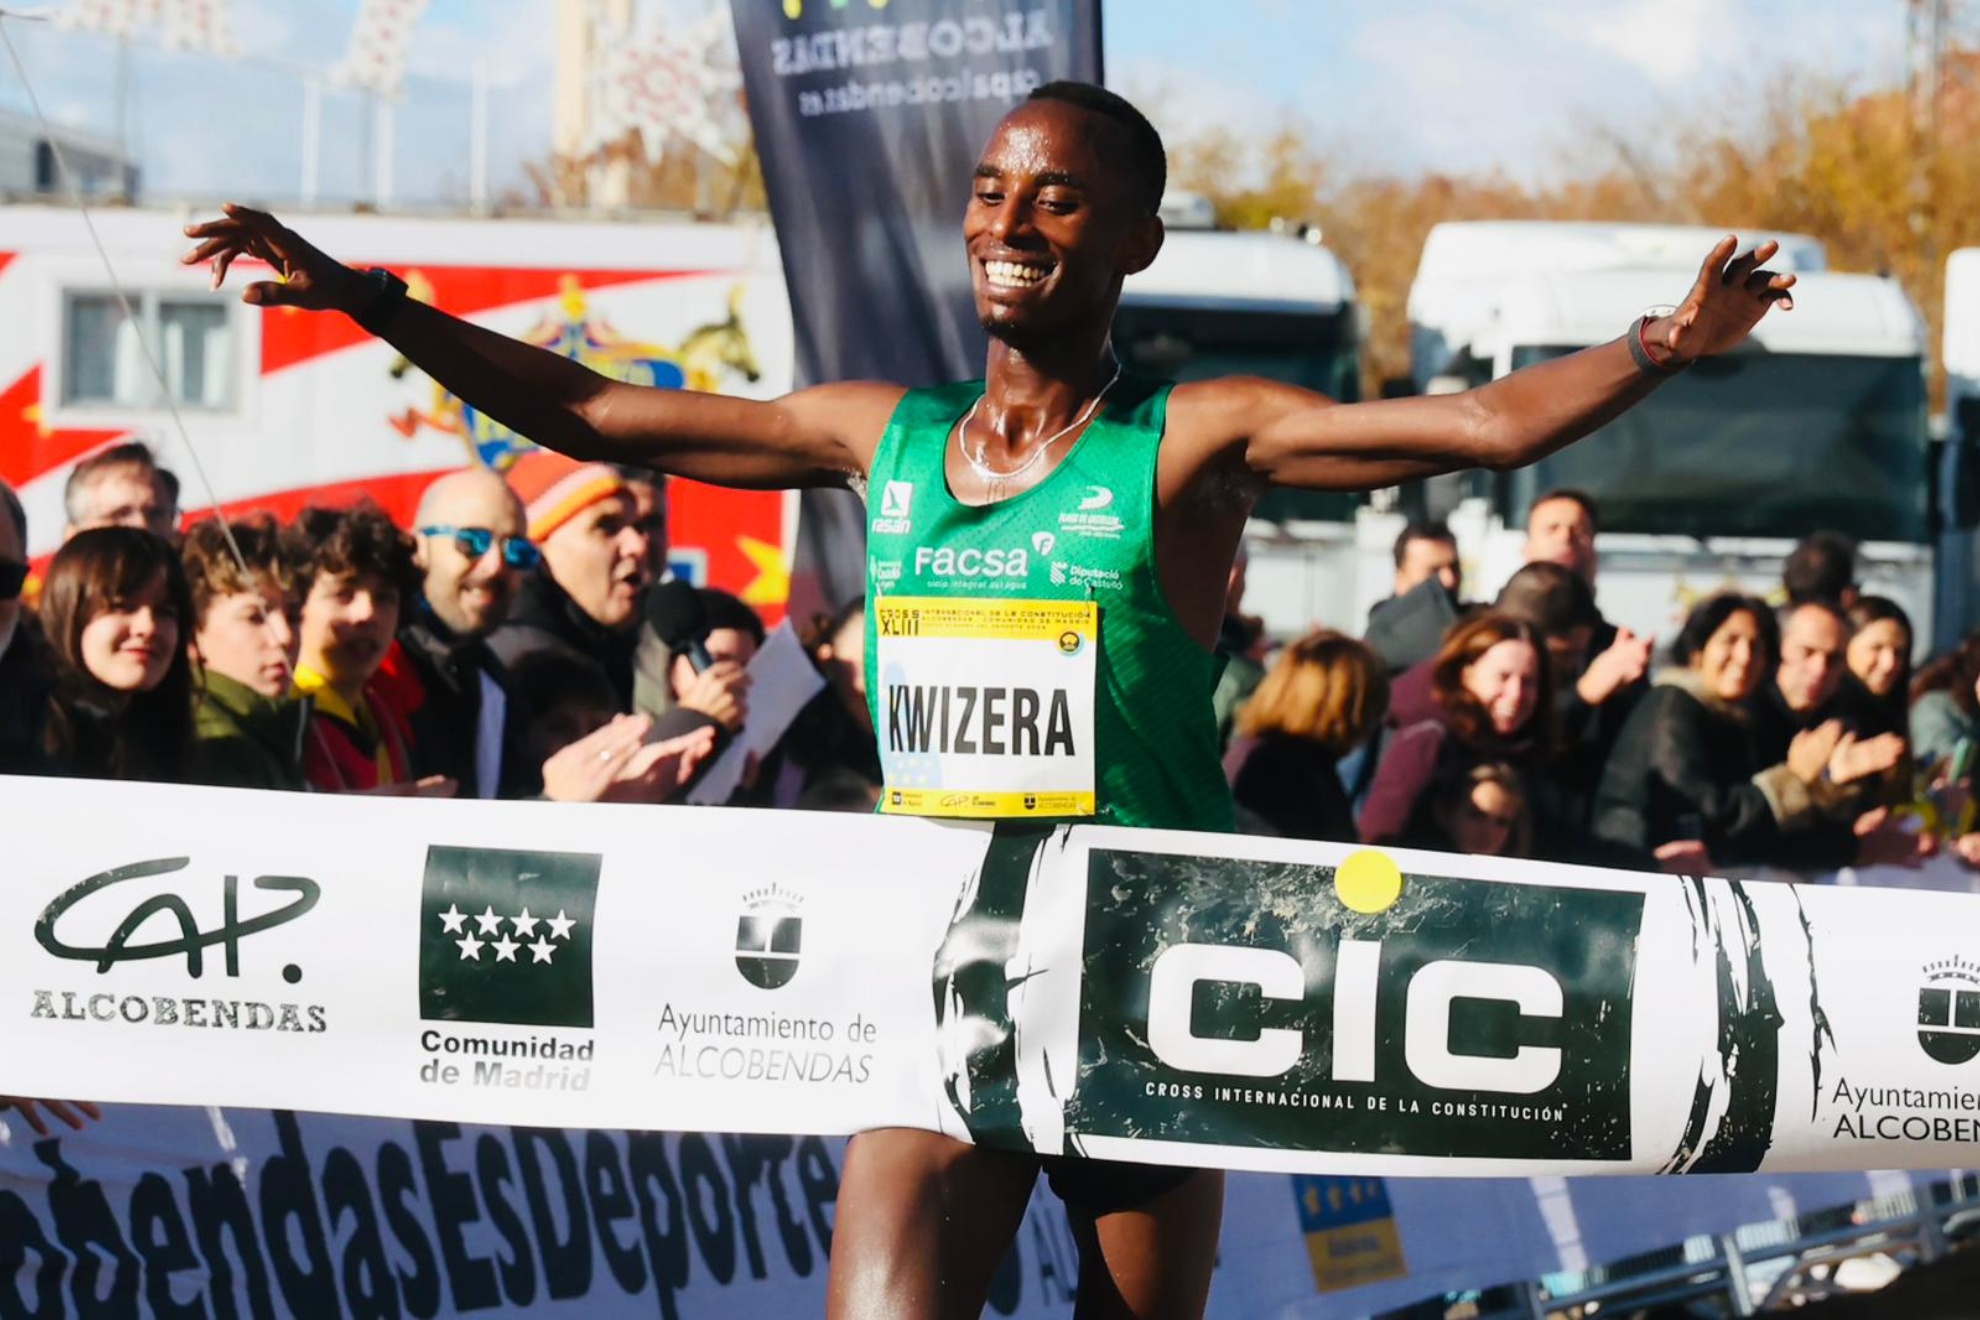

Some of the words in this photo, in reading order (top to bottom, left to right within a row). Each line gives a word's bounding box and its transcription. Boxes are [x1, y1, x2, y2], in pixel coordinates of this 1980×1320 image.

[879, 608, 920, 619] CROSS
[882, 619, 920, 636] XLIII
[888, 684, 1077, 757] KWIZERA
[30, 989, 328, 1034] ALCOBENDAS
[657, 1002, 834, 1042] Ayuntamiento
[847, 1012, 878, 1044] de
[420, 1029, 595, 1062] Comunidad
[652, 1043, 874, 1085] ALCOBENDAS
[419, 1058, 460, 1085] de
[472, 1060, 593, 1093] Madrid
[1831, 1076, 1980, 1113] Ayuntamie
[1144, 1081, 1204, 1099] CROSS
[1214, 1086, 1356, 1110] INTERNACIONAL
[1366, 1095, 1388, 1112] DE
[1398, 1098, 1421, 1114] LA
[1430, 1101, 1564, 1123] CONSTITUCIÓN
